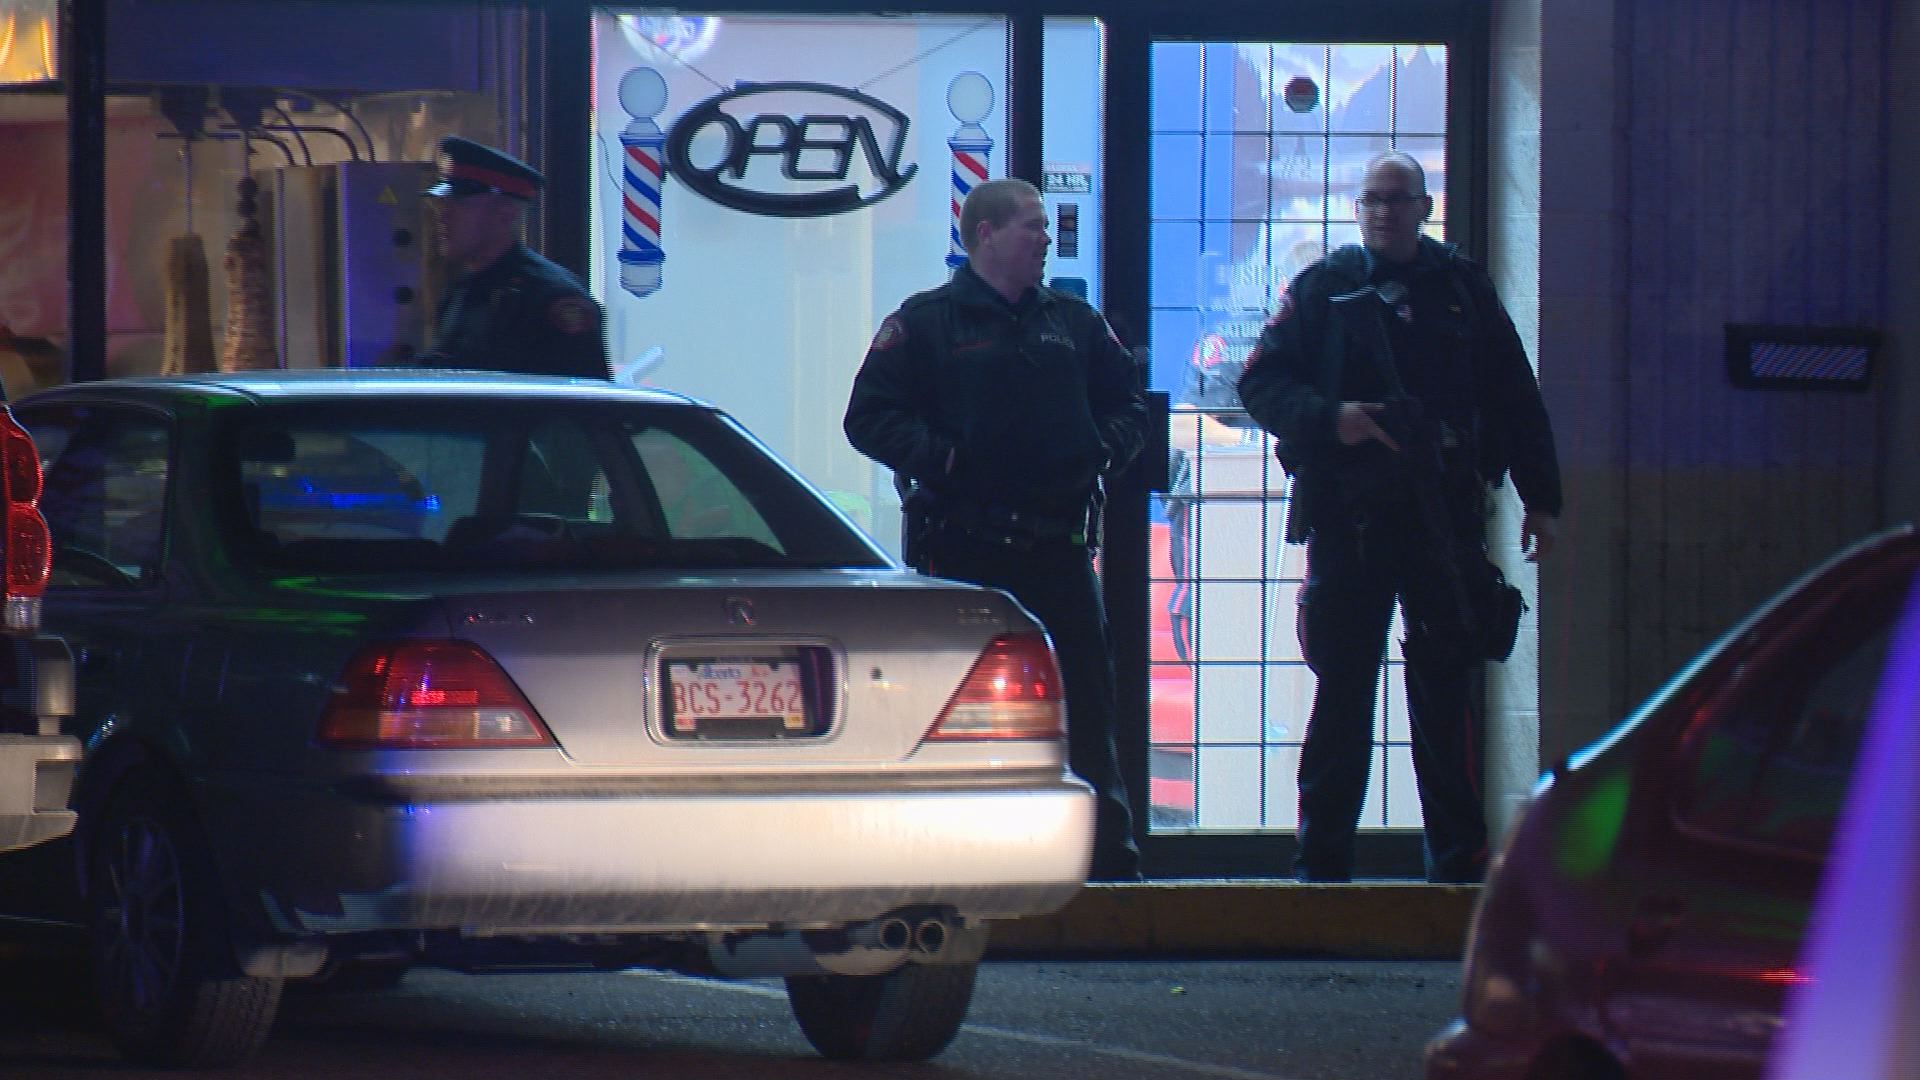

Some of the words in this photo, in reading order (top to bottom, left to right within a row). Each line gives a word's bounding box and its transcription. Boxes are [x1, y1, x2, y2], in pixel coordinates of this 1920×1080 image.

[674, 113, 911, 182] OPEN
[1047, 175, 1064, 187] 24
[672, 682, 802, 715] BCS-3262
